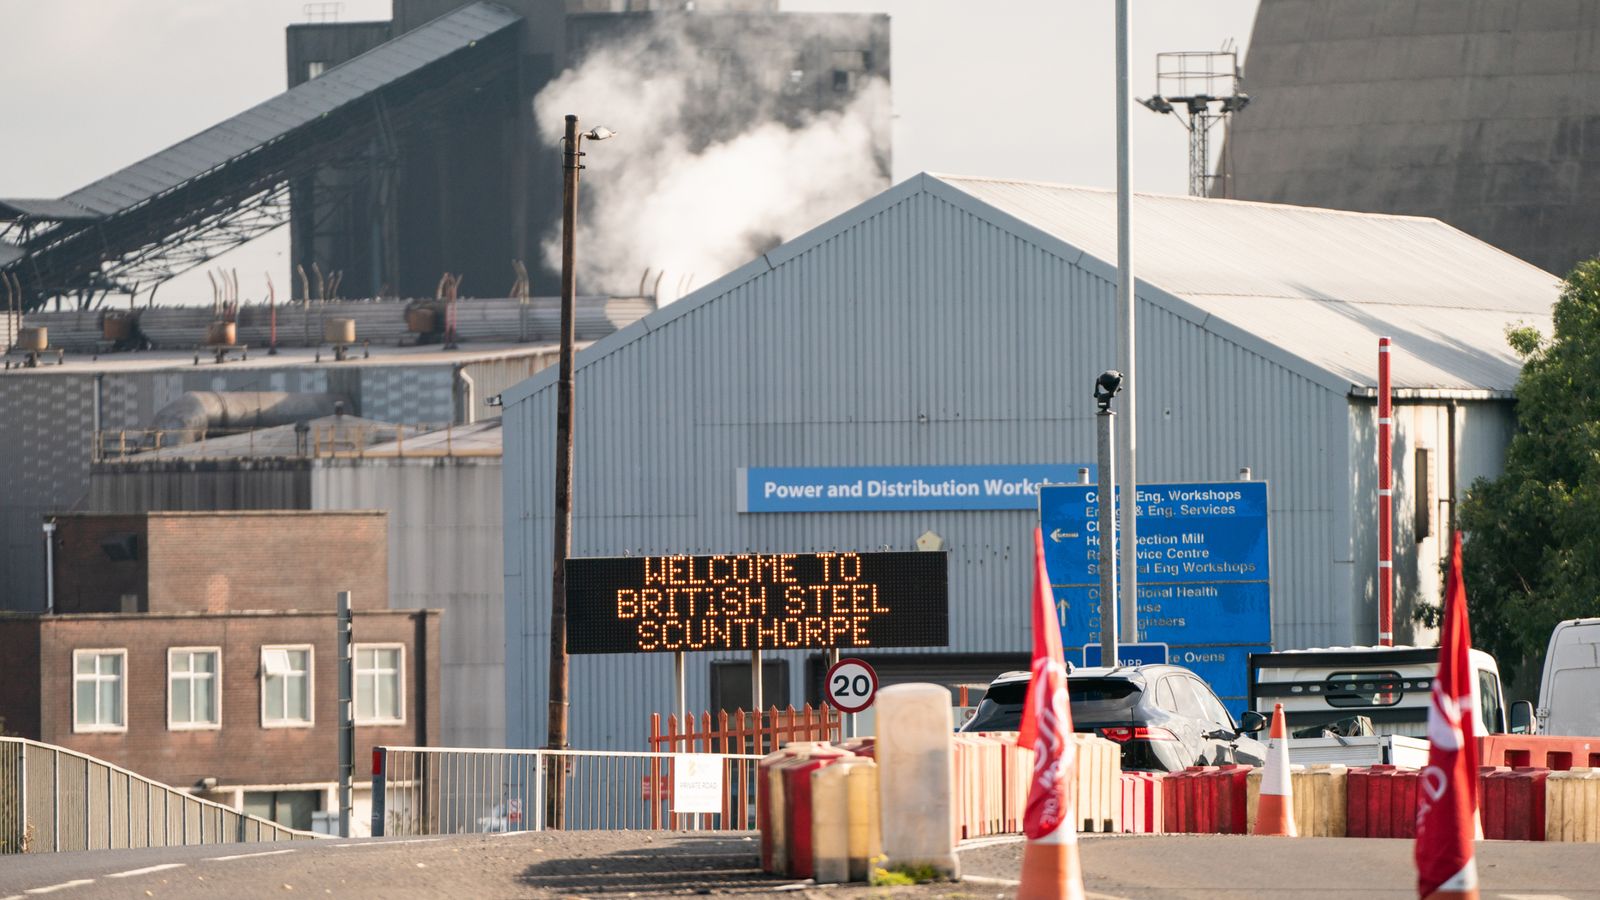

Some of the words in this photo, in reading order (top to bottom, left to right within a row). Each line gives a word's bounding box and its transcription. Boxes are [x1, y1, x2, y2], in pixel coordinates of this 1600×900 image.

[764, 481, 823, 498] Power
[827, 480, 862, 497] and
[867, 478, 980, 496] Distribution
[984, 476, 1078, 494] Works
[1136, 491, 1164, 503] Eng.
[1168, 490, 1241, 502] Workshops
[1148, 505, 1176, 517] Eng.
[1180, 503, 1236, 515] Services
[1182, 533, 1204, 544] Mill
[1167, 548, 1209, 559] Centre
[645, 554, 798, 586] WELCOME
[816, 552, 861, 582] TO
[1154, 563, 1178, 575] Eng
[1183, 562, 1256, 574] Workshops
[1176, 586, 1218, 598] Health
[617, 586, 767, 619] BRITISH
[785, 584, 890, 614] STEEL
[637, 616, 870, 650] SCUNTHORPE
[1184, 652, 1226, 663] Ovens
[833, 674, 870, 698] 20
